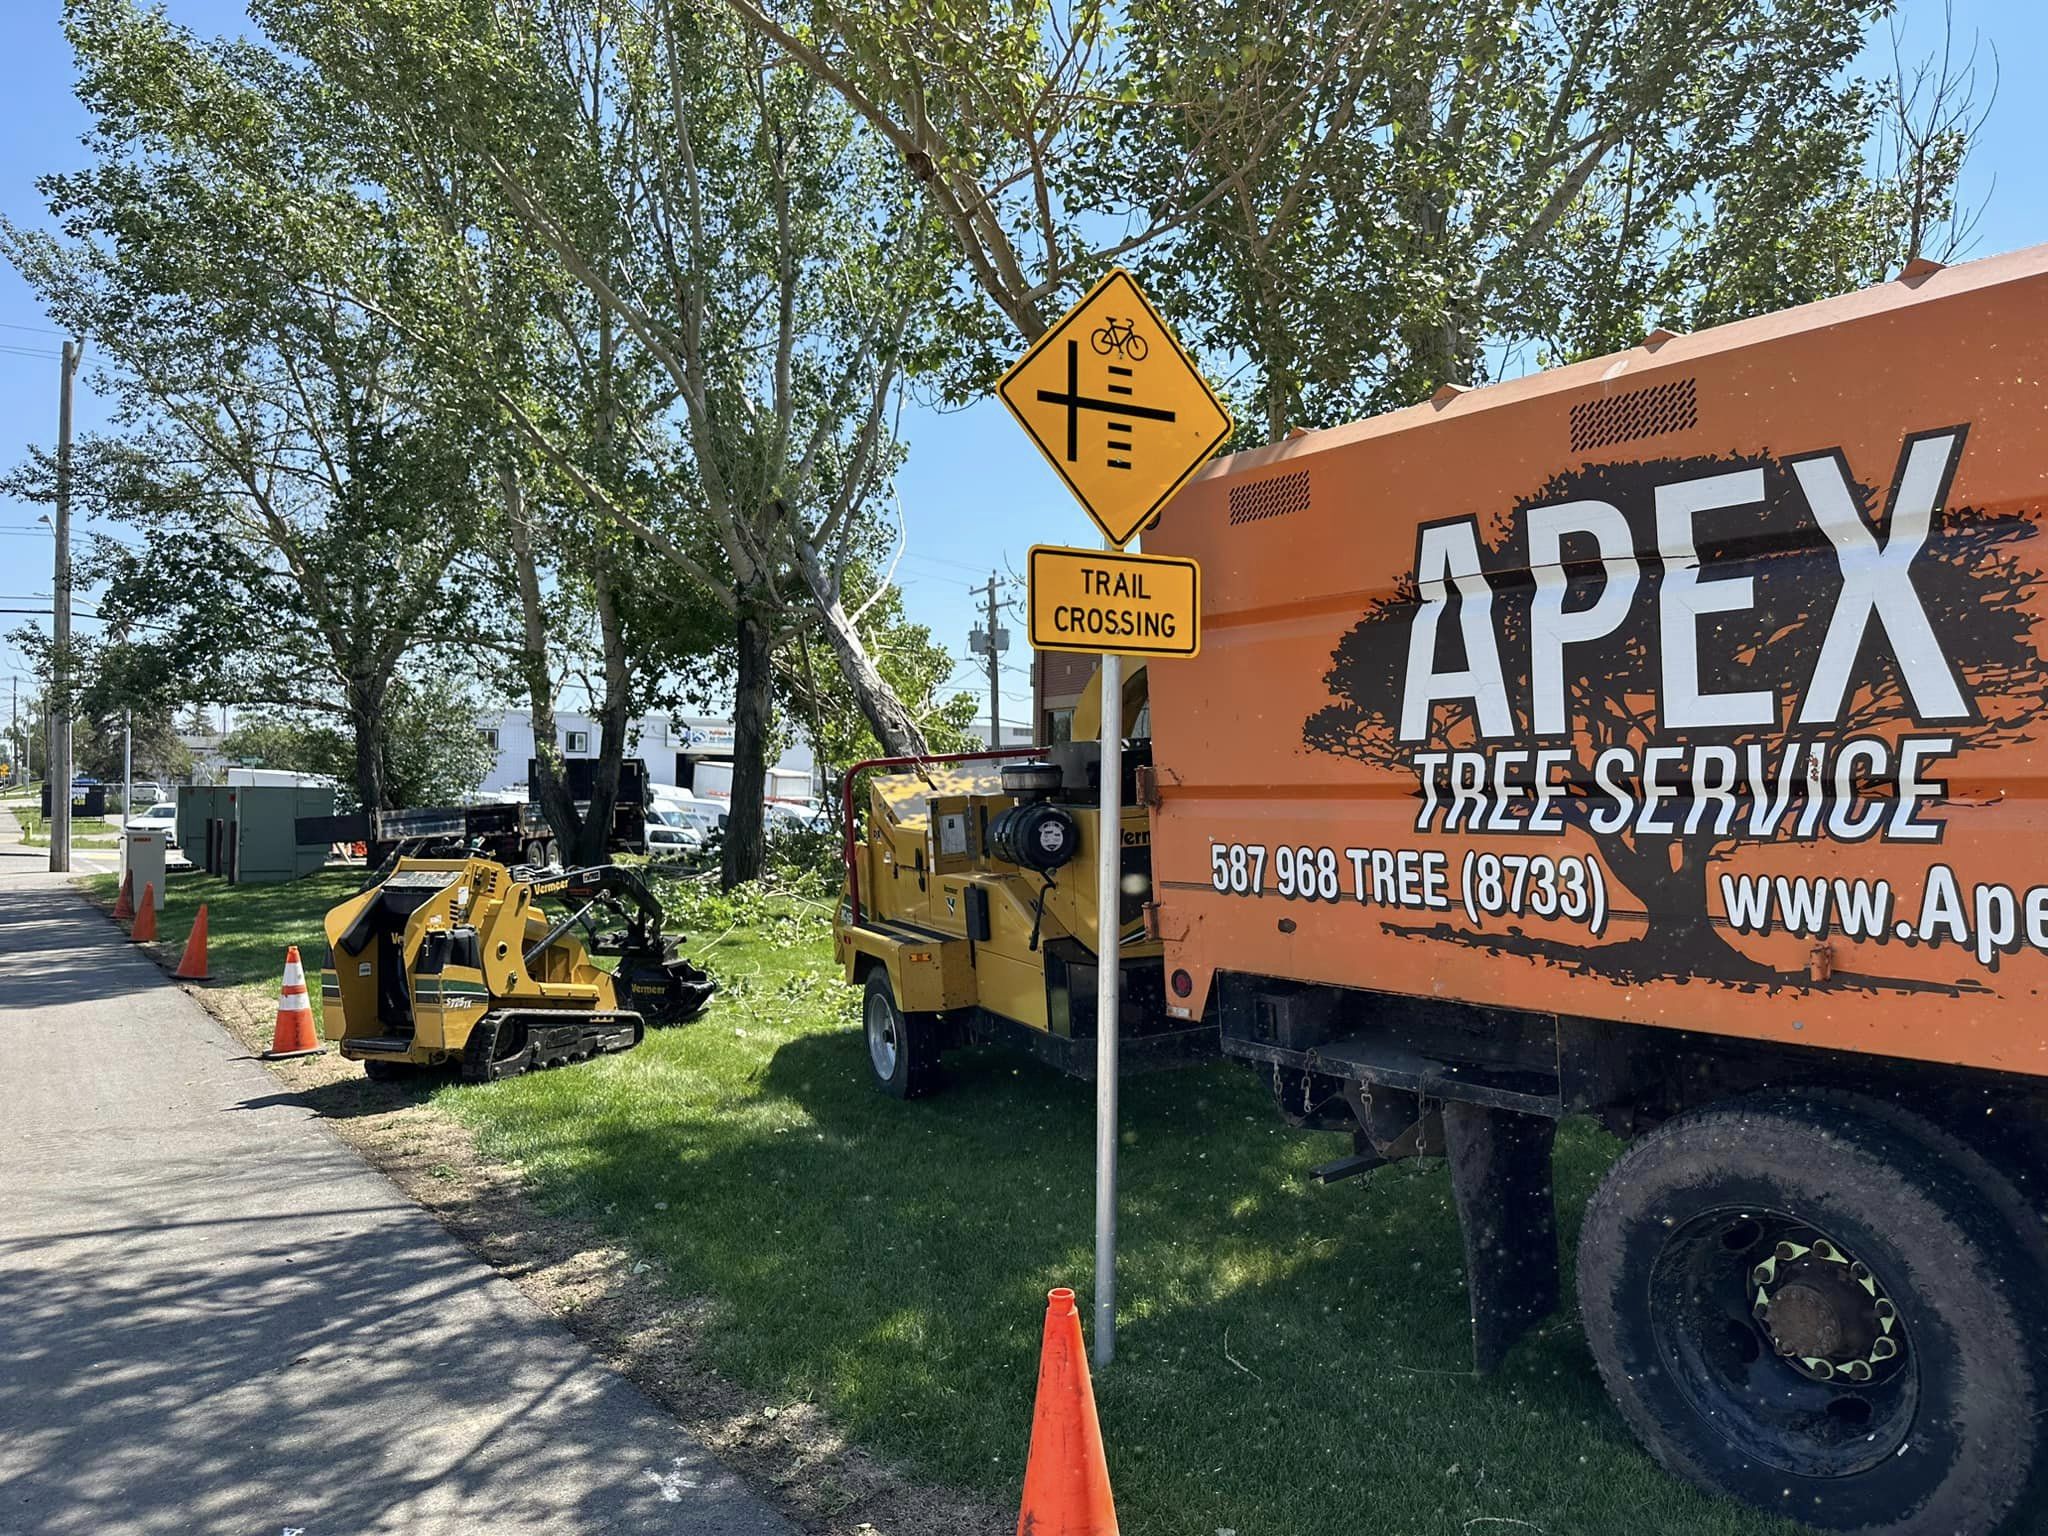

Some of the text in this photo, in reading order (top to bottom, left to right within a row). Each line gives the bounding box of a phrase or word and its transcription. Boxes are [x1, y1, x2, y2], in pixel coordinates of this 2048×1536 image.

[1080, 568, 1152, 600] TRAIL
[1397, 431, 1974, 743] APEX
[1054, 605, 1176, 638] CROSSING
[1411, 736, 1957, 840] TREE SERVICE
[533, 880, 569, 895] Vermeer
[1210, 843, 1609, 936] 587 968 TREE (8733)
